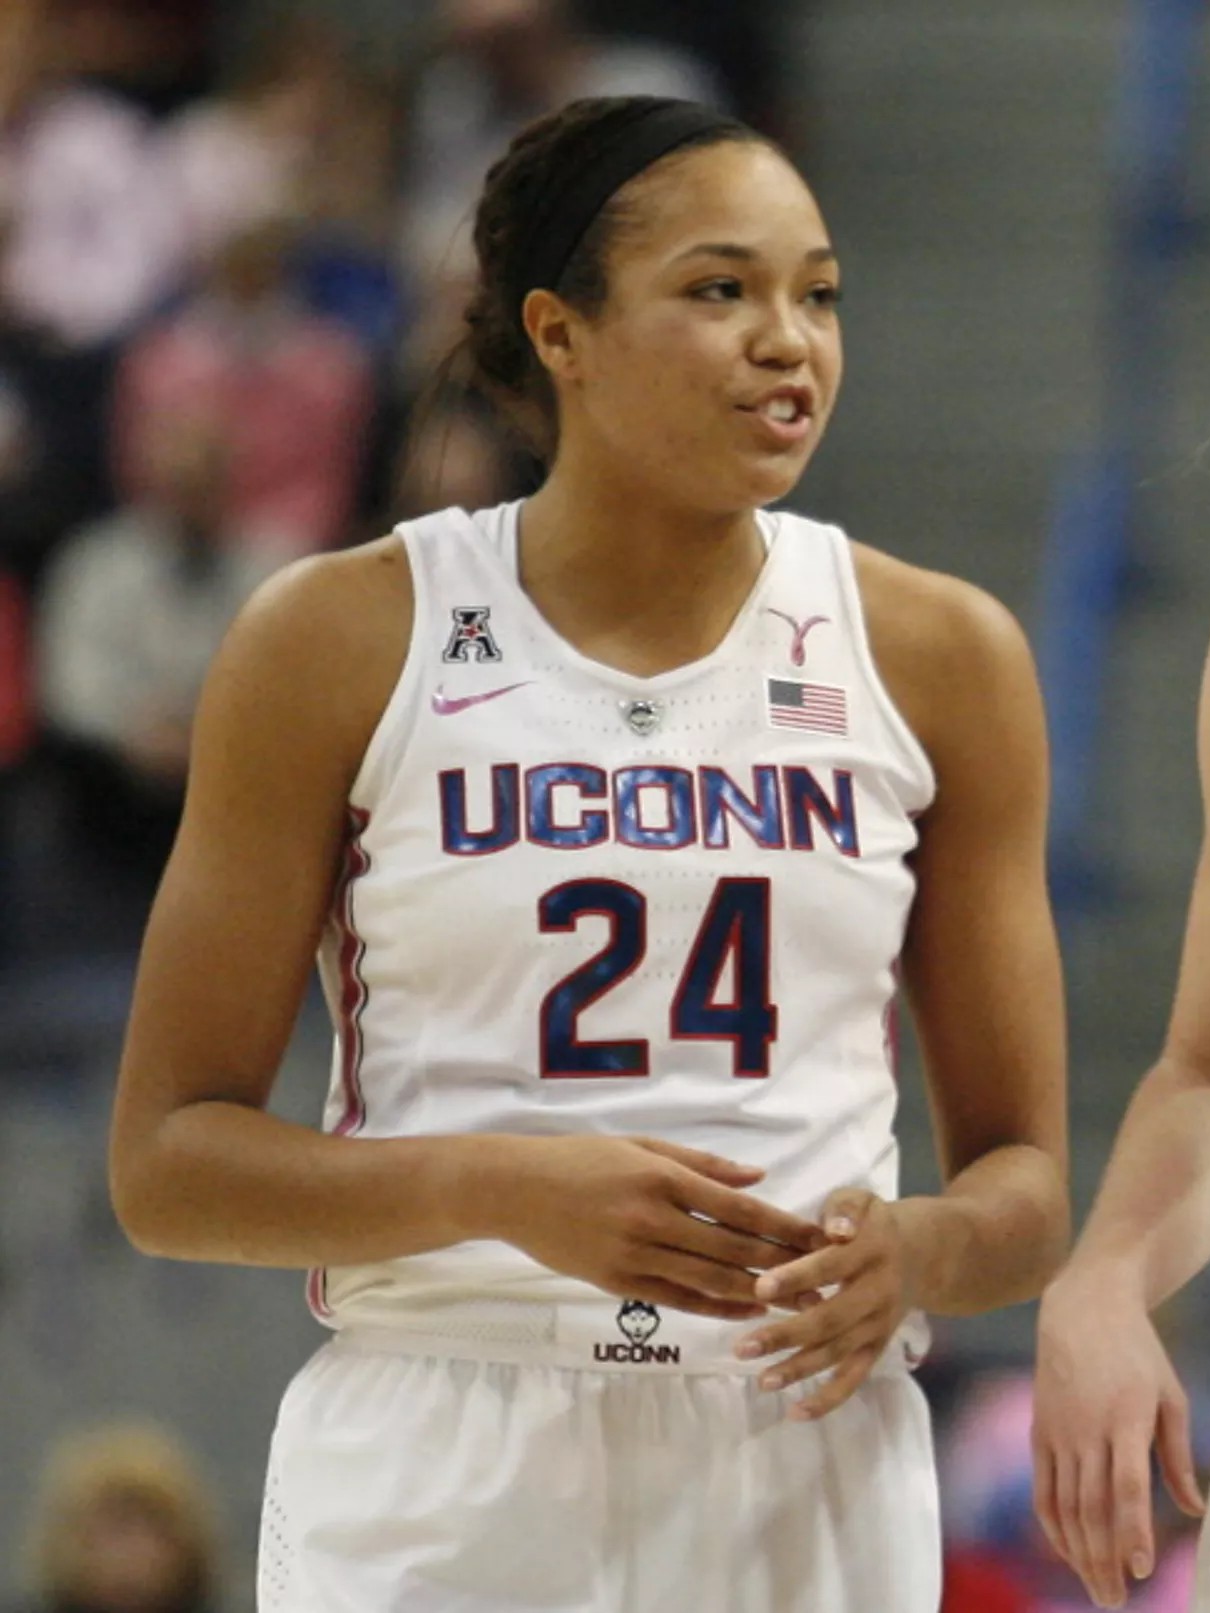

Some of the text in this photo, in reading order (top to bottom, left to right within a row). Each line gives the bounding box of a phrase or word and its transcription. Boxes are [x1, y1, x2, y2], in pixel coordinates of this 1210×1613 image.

[438, 762, 861, 858] UCONN
[538, 877, 778, 1078] 24
[594, 1343, 680, 1363] UCONN
